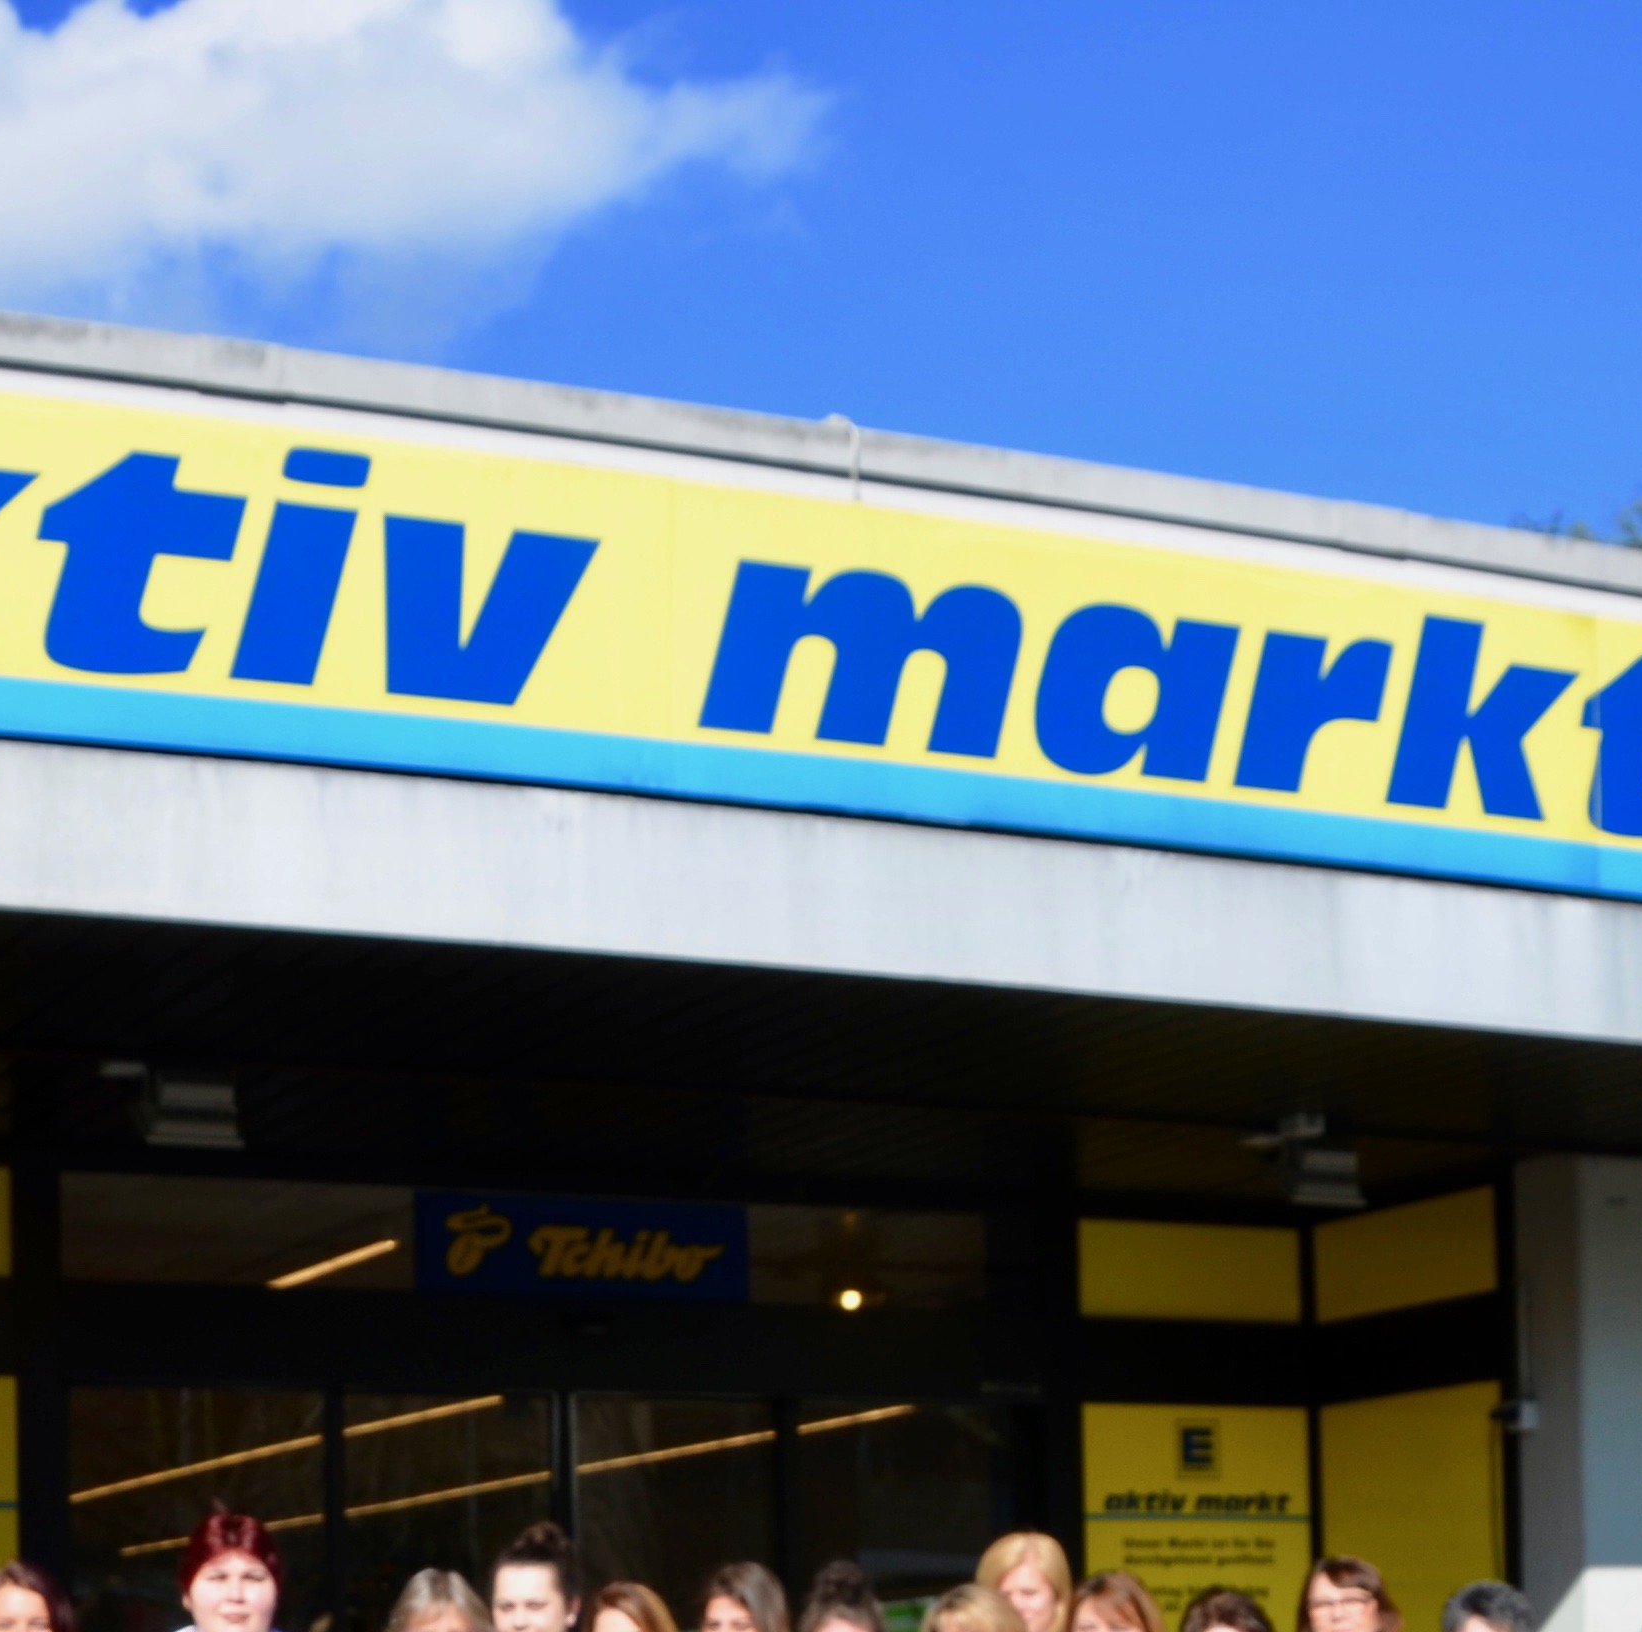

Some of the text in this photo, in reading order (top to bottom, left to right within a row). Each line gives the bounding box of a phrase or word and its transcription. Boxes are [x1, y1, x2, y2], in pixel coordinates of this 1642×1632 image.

[527, 1225, 724, 1281] Tchibo
[1182, 1427, 1213, 1464] E
[1104, 1488, 1290, 1512] aktiv markt
